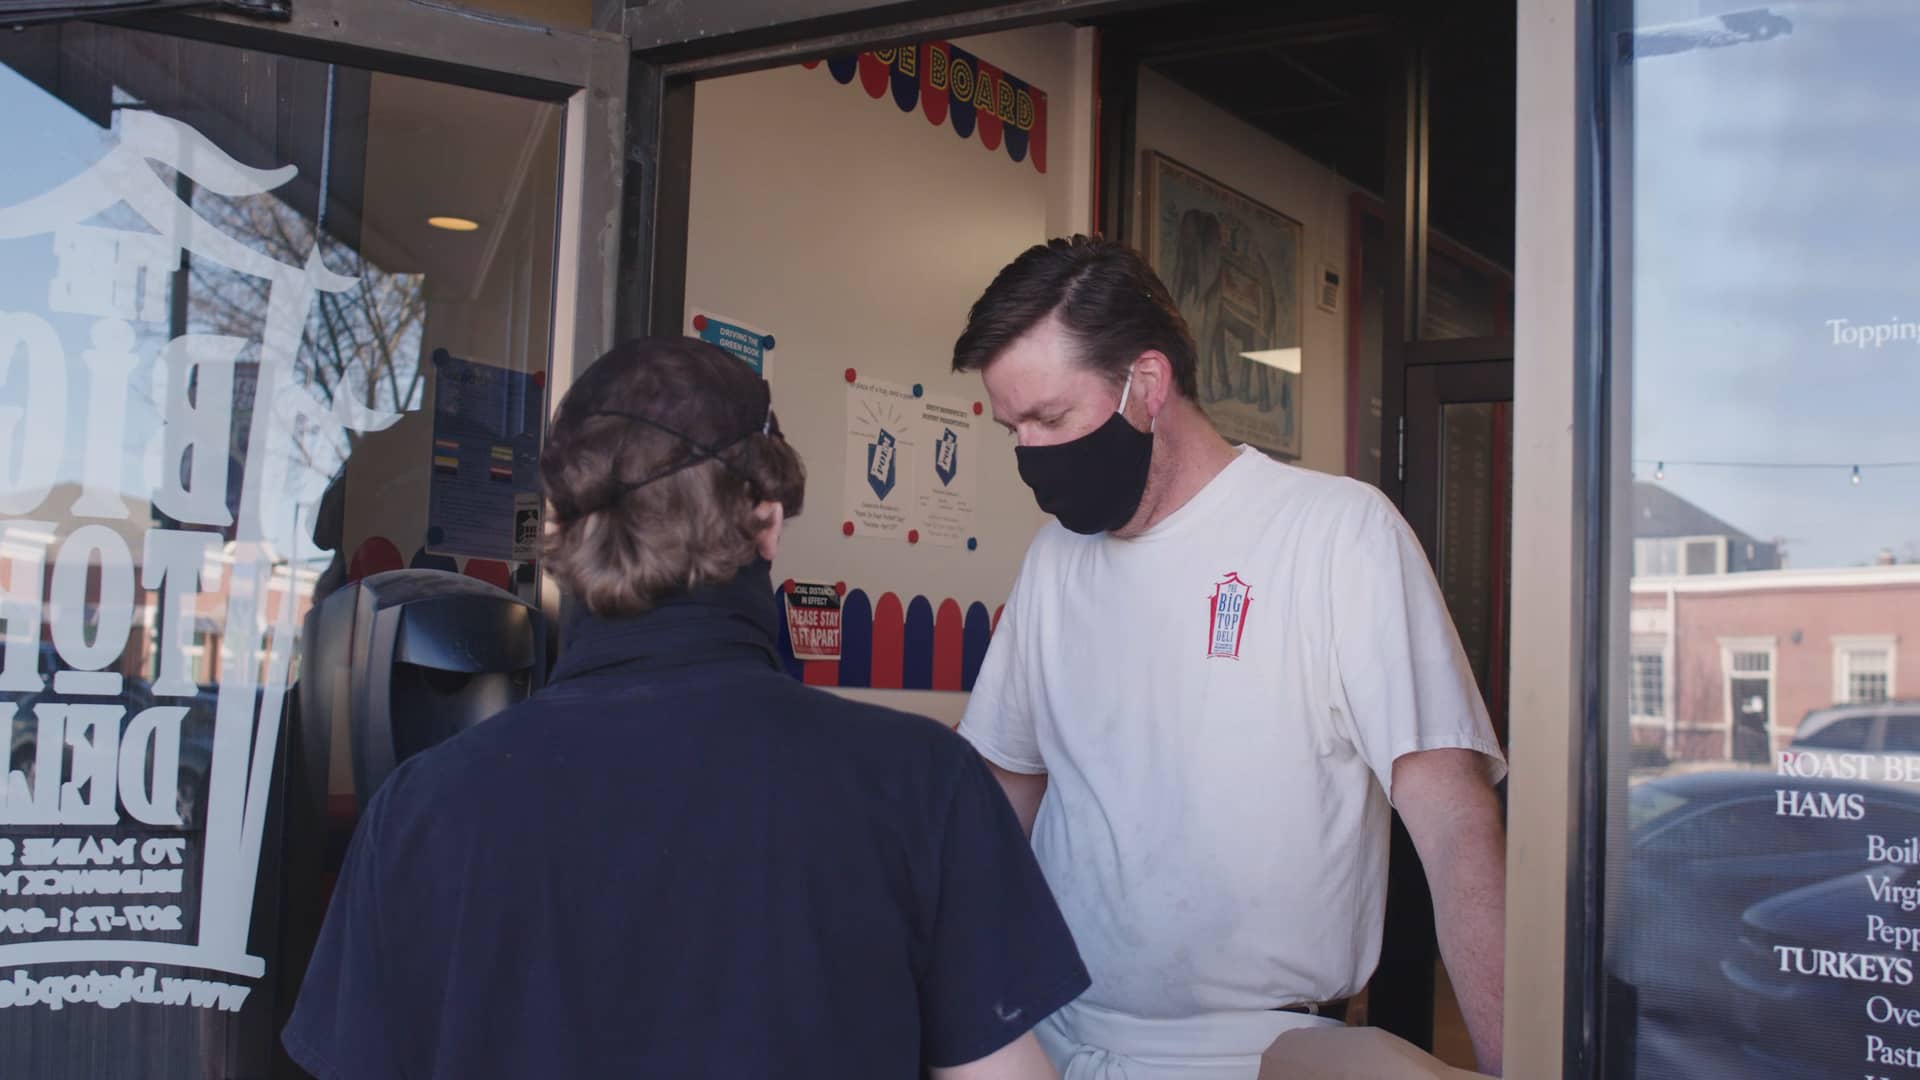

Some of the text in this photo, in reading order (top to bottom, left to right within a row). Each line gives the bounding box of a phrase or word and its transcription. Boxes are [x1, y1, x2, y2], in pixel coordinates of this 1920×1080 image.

[930, 47, 1034, 130] BOARD
[1824, 314, 1920, 350] Toppin
[808, 597, 828, 606] EFFECT
[790, 608, 839, 628] PLEASE STAY
[1217, 613, 1239, 630] TOP
[810, 628, 839, 648] APART
[1216, 630, 1234, 643] DELI
[1776, 751, 1874, 781] ROAST
[1776, 789, 1866, 820] HAMS
[1866, 834, 1920, 865] Boil
[1773, 945, 1914, 985] TURKEYS
